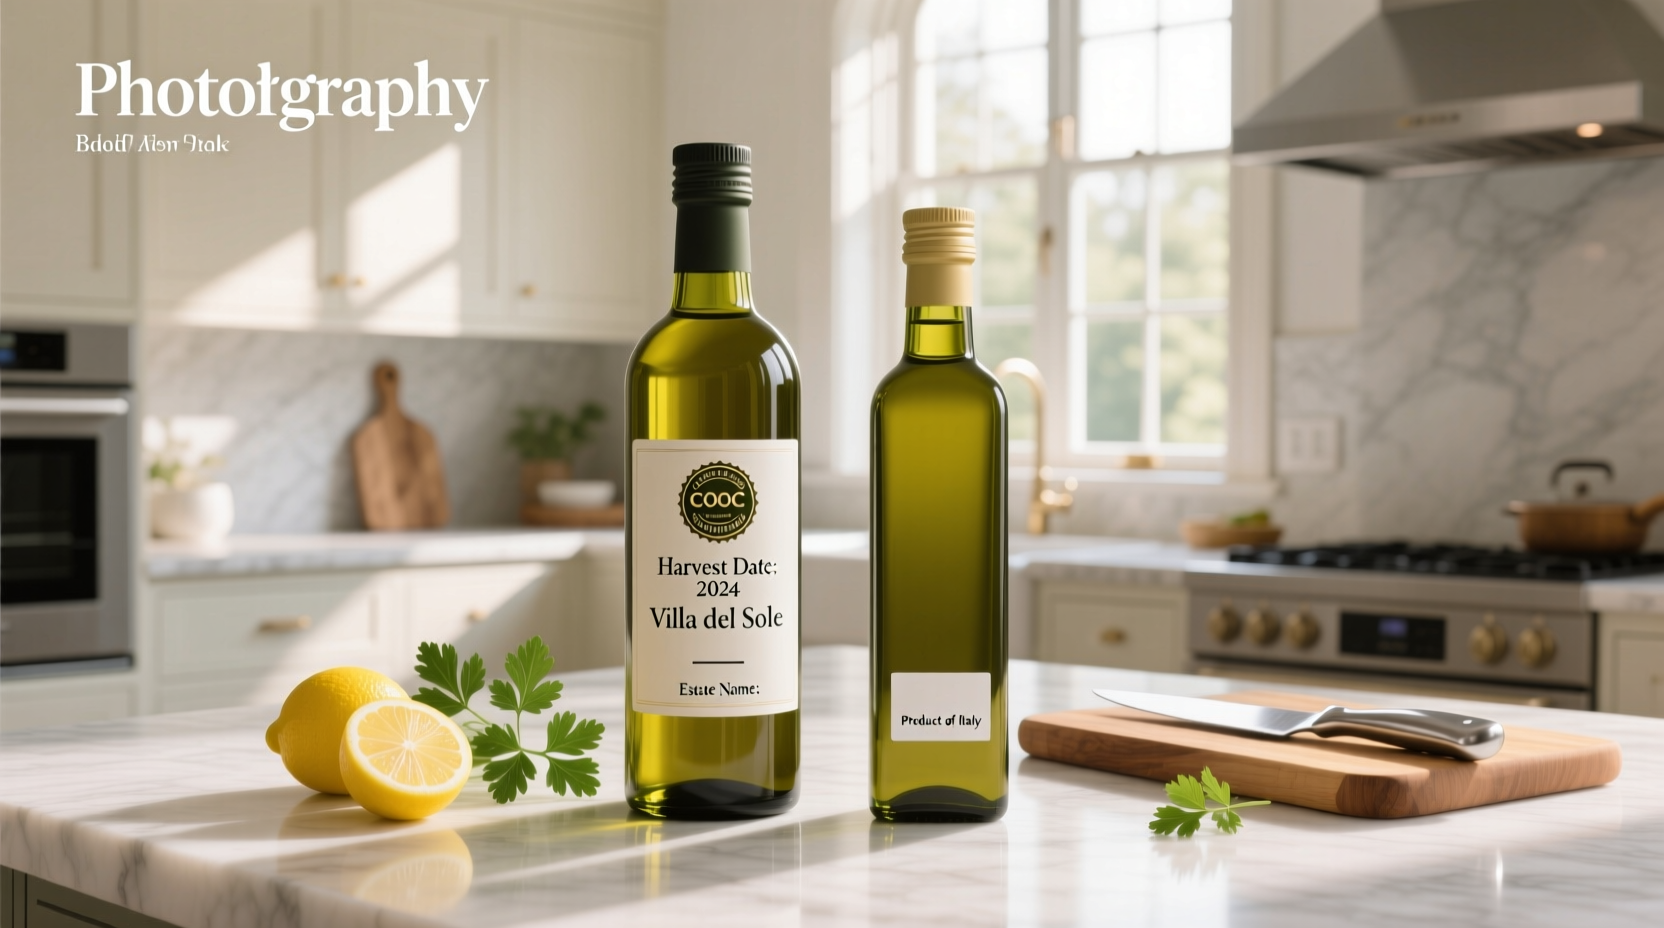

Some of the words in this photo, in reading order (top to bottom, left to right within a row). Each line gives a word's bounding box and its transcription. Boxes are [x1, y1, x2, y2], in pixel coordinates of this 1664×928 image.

[690, 491, 745, 508] COOC
[657, 556, 728, 576] Harvest
[696, 580, 741, 598] 2024
[649, 605, 698, 630] Villa
[703, 606, 736, 630] del
[742, 604, 784, 630] Sole
[719, 681, 760, 697] Name:
[901, 713, 942, 727] Product
[945, 713, 956, 728] of
